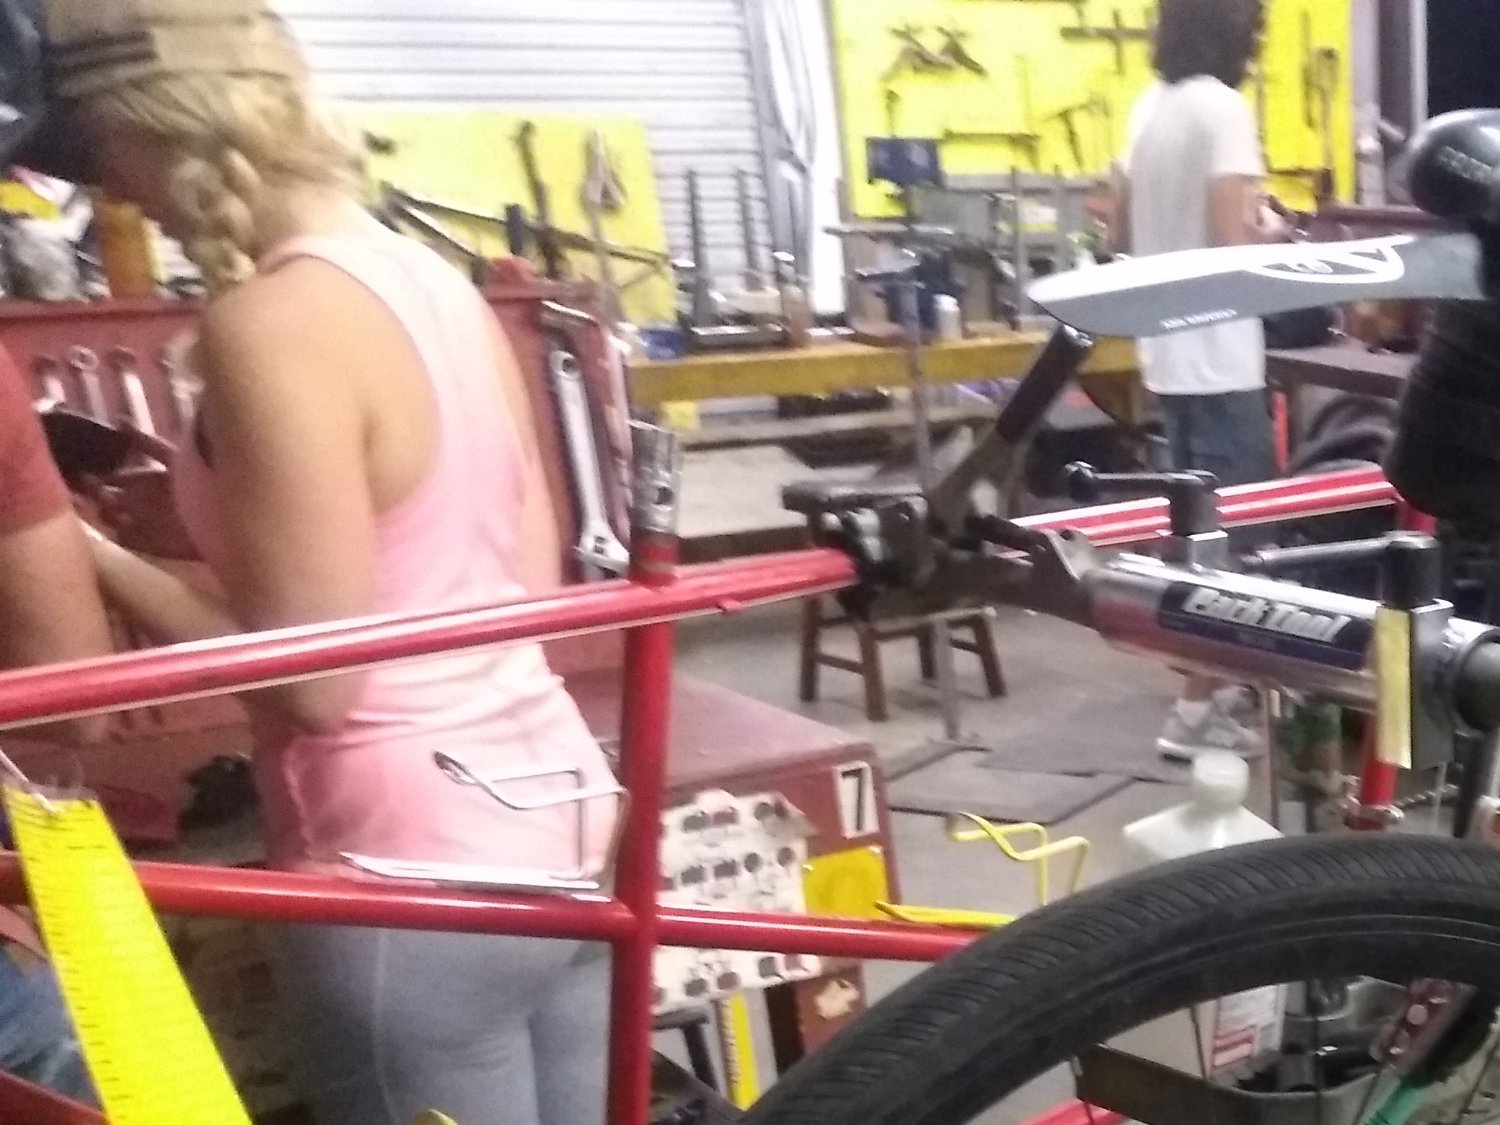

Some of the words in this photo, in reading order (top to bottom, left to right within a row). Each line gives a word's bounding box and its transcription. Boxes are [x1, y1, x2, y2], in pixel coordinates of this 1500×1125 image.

[1181, 586, 1270, 627] Park
[1264, 602, 1352, 643] Tool
[841, 767, 863, 831] 7
